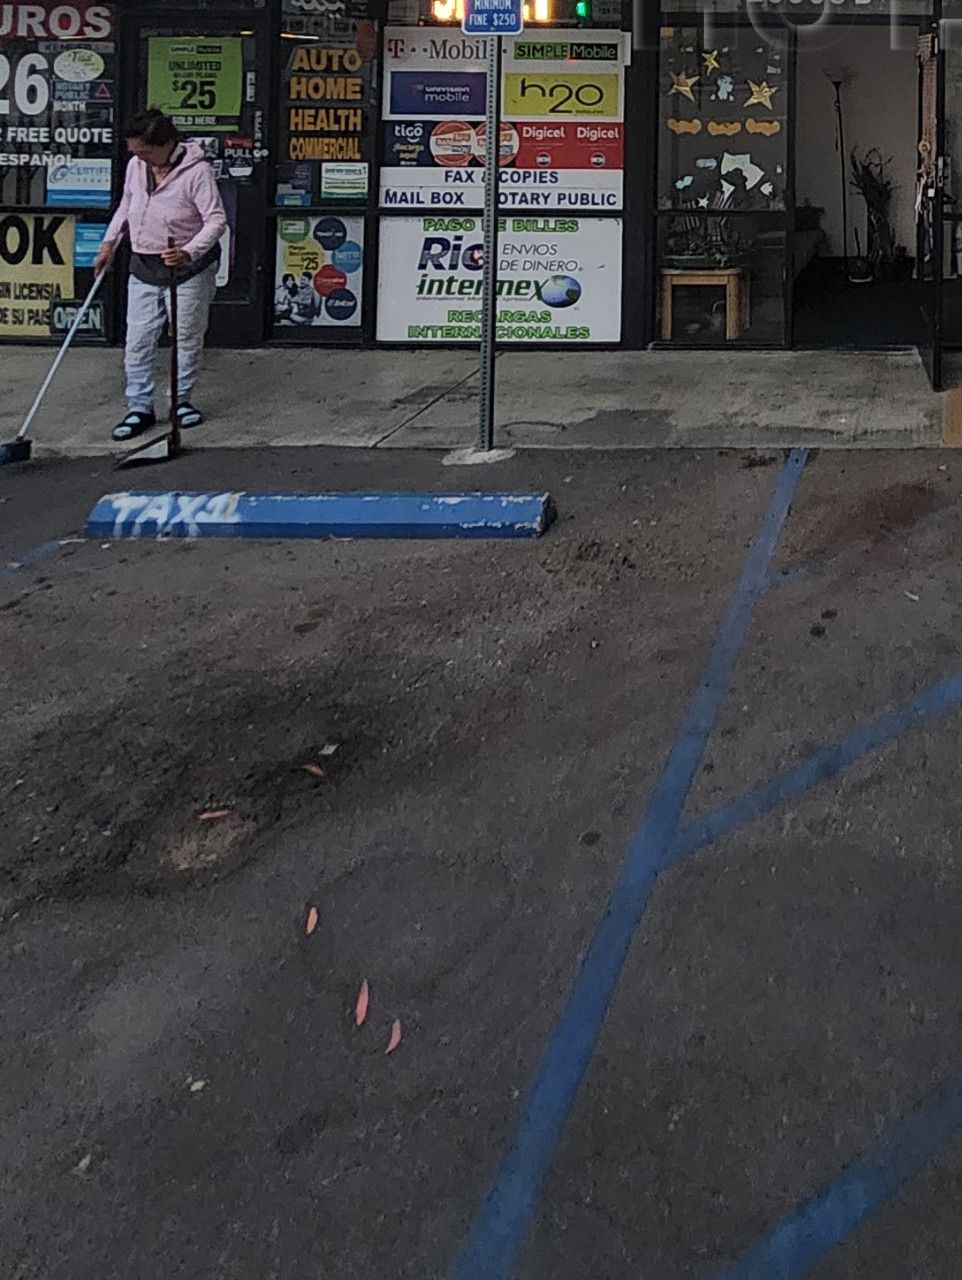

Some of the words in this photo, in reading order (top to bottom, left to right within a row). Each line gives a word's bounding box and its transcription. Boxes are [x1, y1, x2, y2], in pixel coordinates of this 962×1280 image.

[469, 14, 488, 26] FINE
[492, 13, 517, 26] $250
[516, 43, 568, 58] SIMPLE
[573, 44, 616, 58] Mobile
[291, 48, 363, 71] AUTO
[171, 80, 217, 110] $25
[290, 78, 363, 100] HOME
[425, 92, 470, 102] mobile
[290, 108, 363, 131] HEALTH
[7, 127, 50, 143] FREE
[54, 127, 113, 144] QUOTE
[522, 126, 566, 140] Digicel
[577, 127, 620, 141] Digicel
[224, 148, 251, 158] PULL
[290, 137, 361, 160] COMMERCIAL
[444, 170, 476, 184] FAX
[499, 171, 559, 184] COPIES
[384, 191, 424, 205] MAIL
[430, 192, 465, 205] BOX
[498, 192, 551, 205] OTARY
[557, 192, 617, 206] PUBLIC
[423, 218, 476, 233] PAGO
[512, 219, 580, 233] BILLES
[0, 215, 65, 266] OK
[502, 244, 558, 256] ENVIOS
[500, 259, 518, 271] DE
[54, 305, 101, 329] OPEN
[447, 310, 552, 323] RECRGAS
[408, 326, 590, 340] INTERNCIONALES
